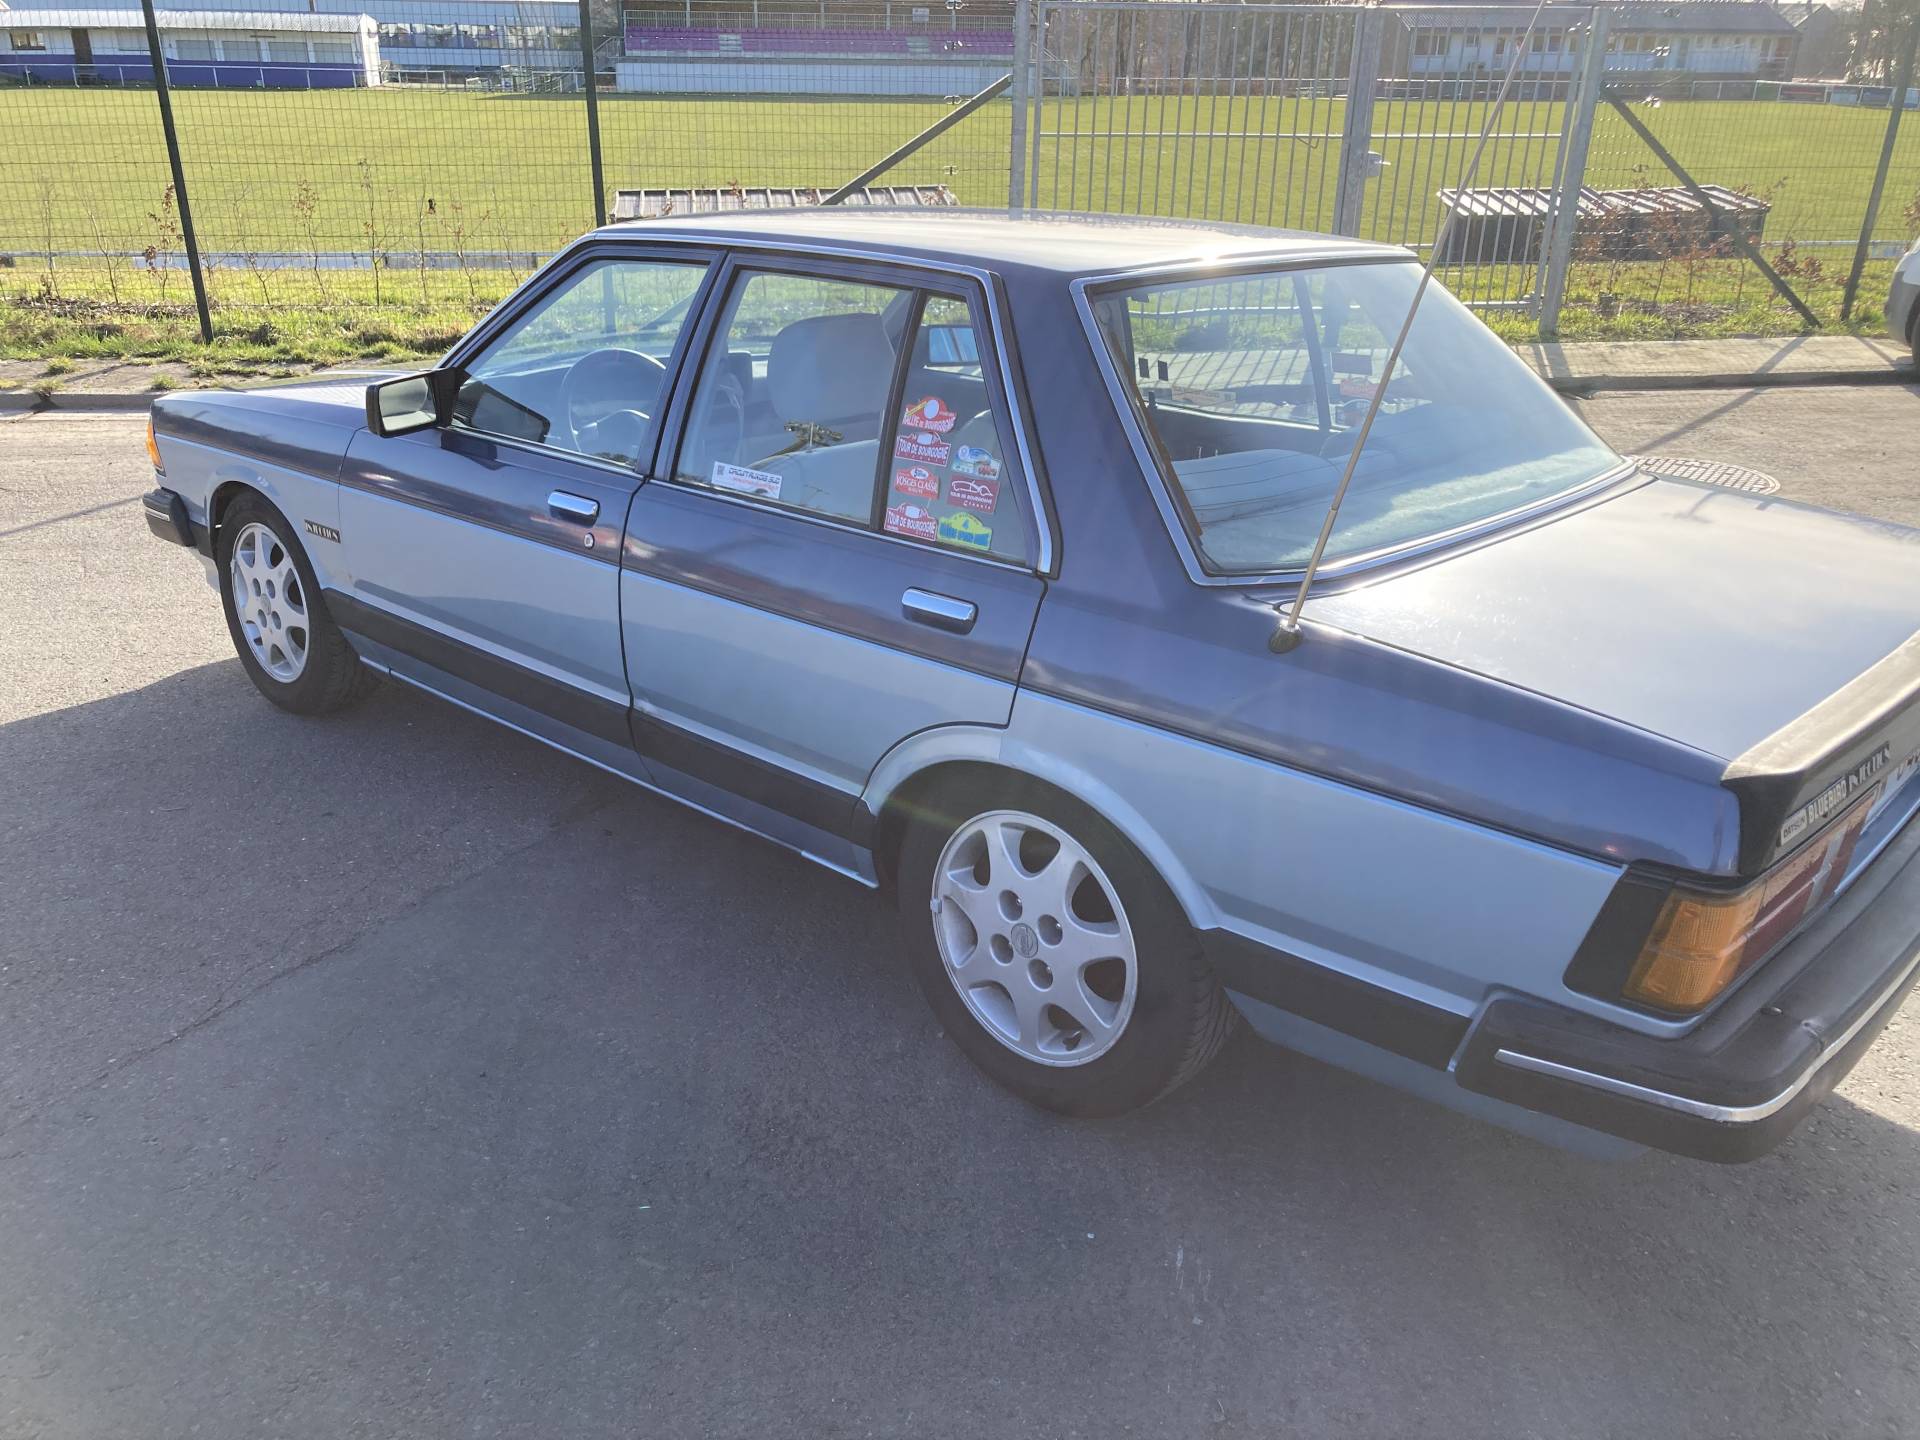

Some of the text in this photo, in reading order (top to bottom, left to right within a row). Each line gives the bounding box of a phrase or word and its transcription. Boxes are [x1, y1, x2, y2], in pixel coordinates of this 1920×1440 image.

[899, 438, 911, 452] TOUR
[911, 444, 918, 455] DE
[918, 445, 949, 459] BOURGOGNE
[887, 511, 899, 525] TOUR
[899, 517, 907, 528] DE
[907, 518, 936, 534] BOURGOGNE
[1808, 779, 1847, 824] BLUEBIRD
